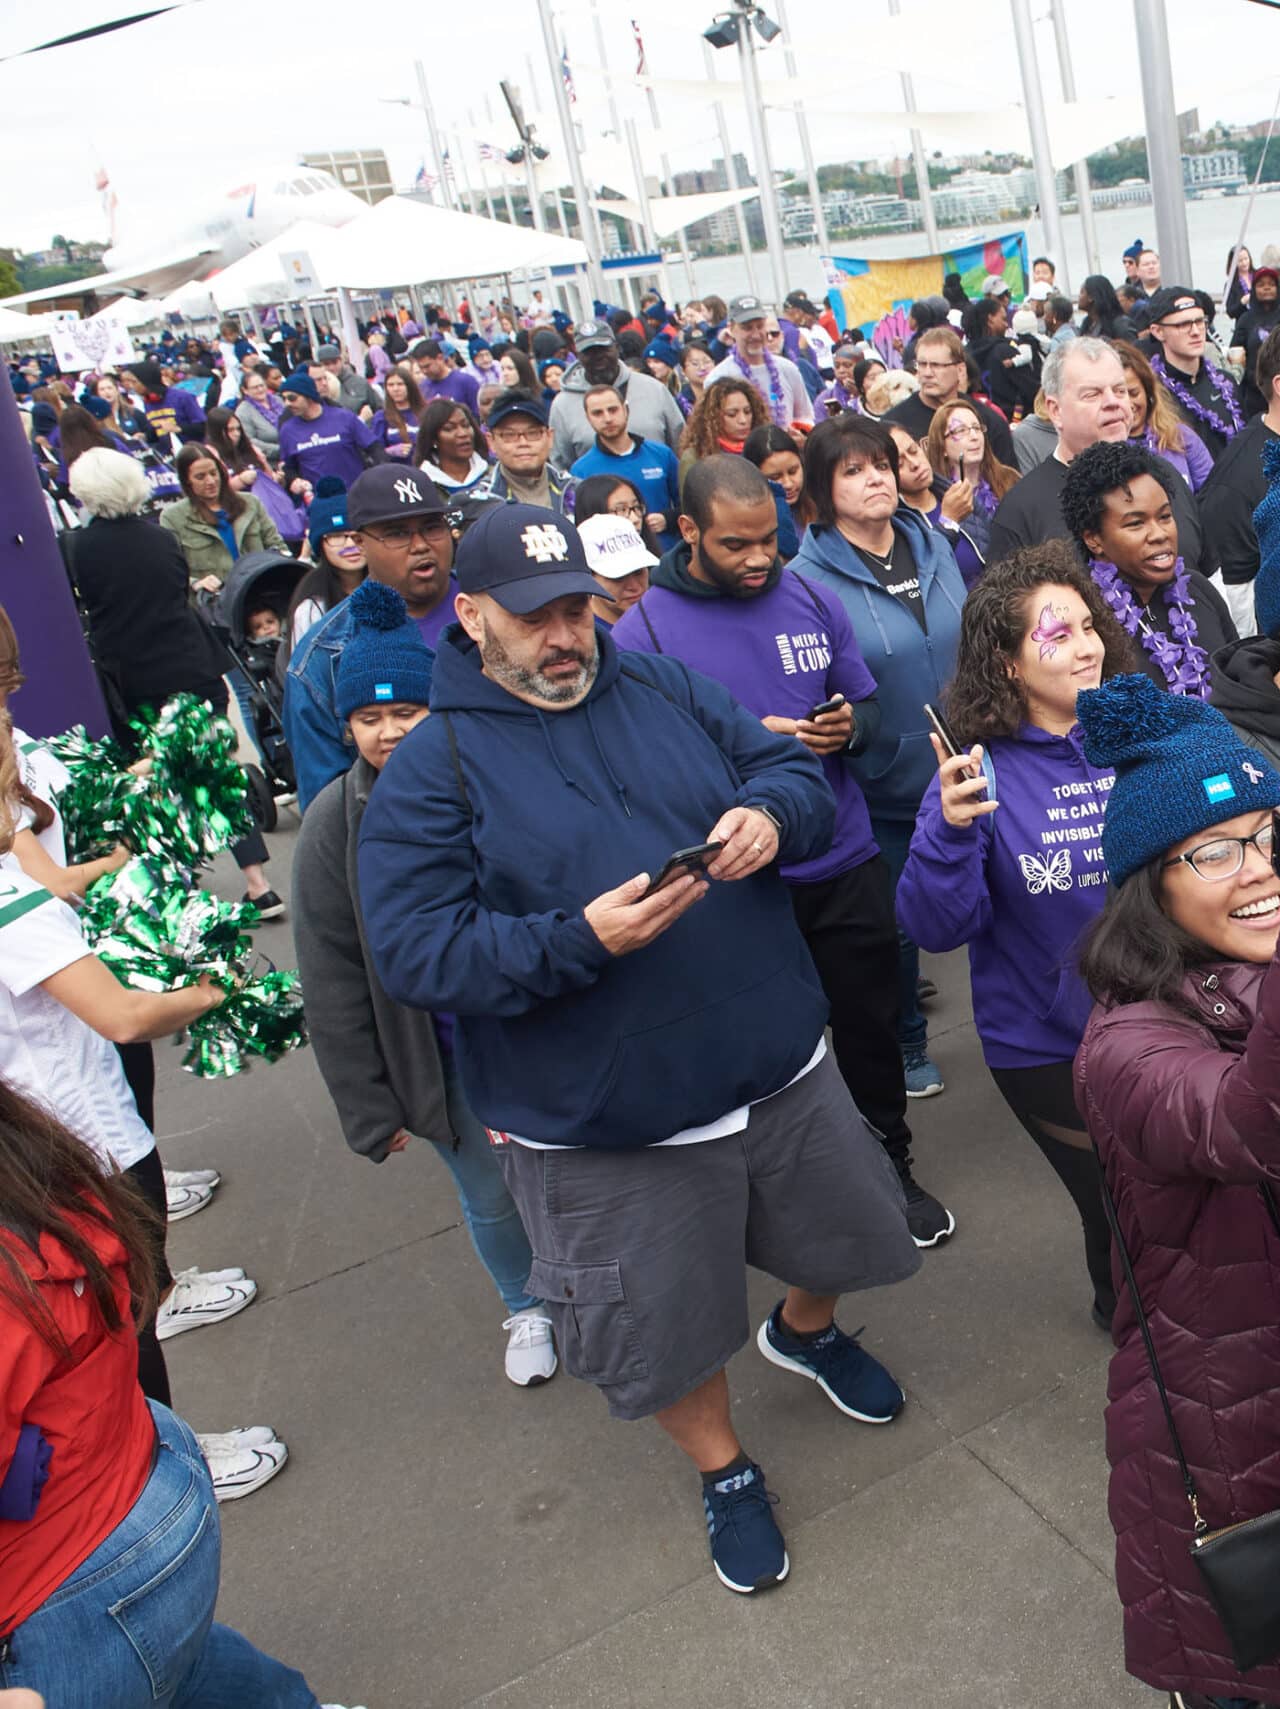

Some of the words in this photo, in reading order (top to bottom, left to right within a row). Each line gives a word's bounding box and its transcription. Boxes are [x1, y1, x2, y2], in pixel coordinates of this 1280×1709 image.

[54, 319, 119, 334] LUPUS
[393, 478, 423, 503] NY
[791, 633, 819, 649] NEEDS
[775, 633, 797, 675] SAMANTHA
[1052, 776, 1116, 800] TOGETHER
[1046, 807, 1069, 821] WE
[1070, 801, 1099, 819] CAN
[1041, 823, 1105, 845] INVISIBLE
[1078, 871, 1101, 888] LUPUS
